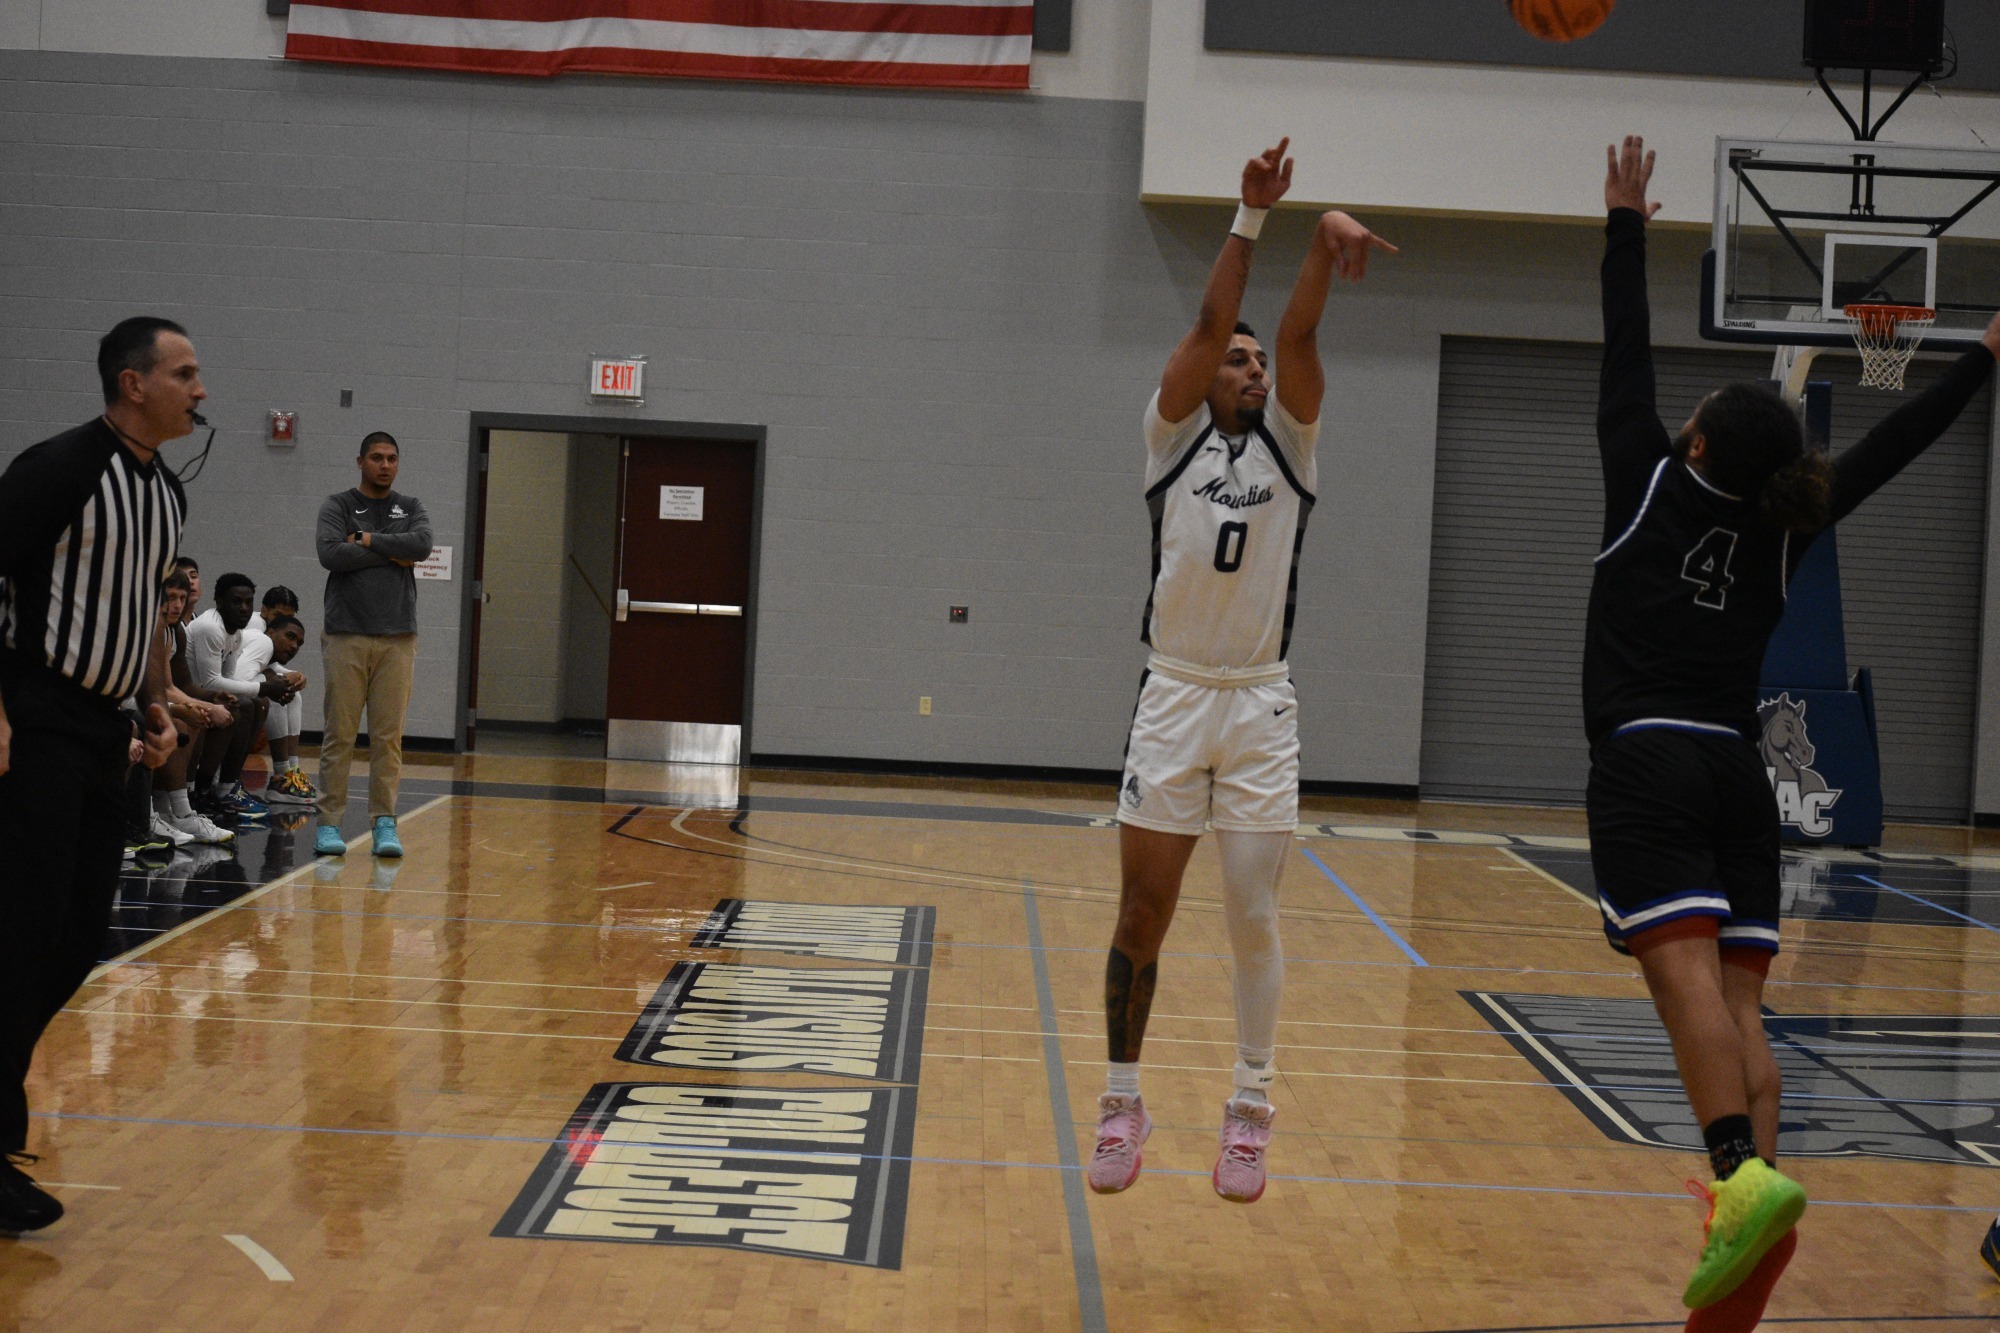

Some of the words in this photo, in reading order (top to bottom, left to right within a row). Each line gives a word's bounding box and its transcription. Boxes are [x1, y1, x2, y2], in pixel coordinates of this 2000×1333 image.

[1722, 320, 1756, 329] SPALDING
[601, 364, 635, 391] EXIT
[1193, 476, 1274, 509] Mounties
[414, 563, 448, 571] Emergency
[1213, 520, 1248, 572] 0
[1680, 526, 1738, 610] 4
[1767, 767, 1843, 837] AC
[650, 963, 894, 1077] ALOYSIUS
[543, 1085, 874, 1256] COLLEGE
